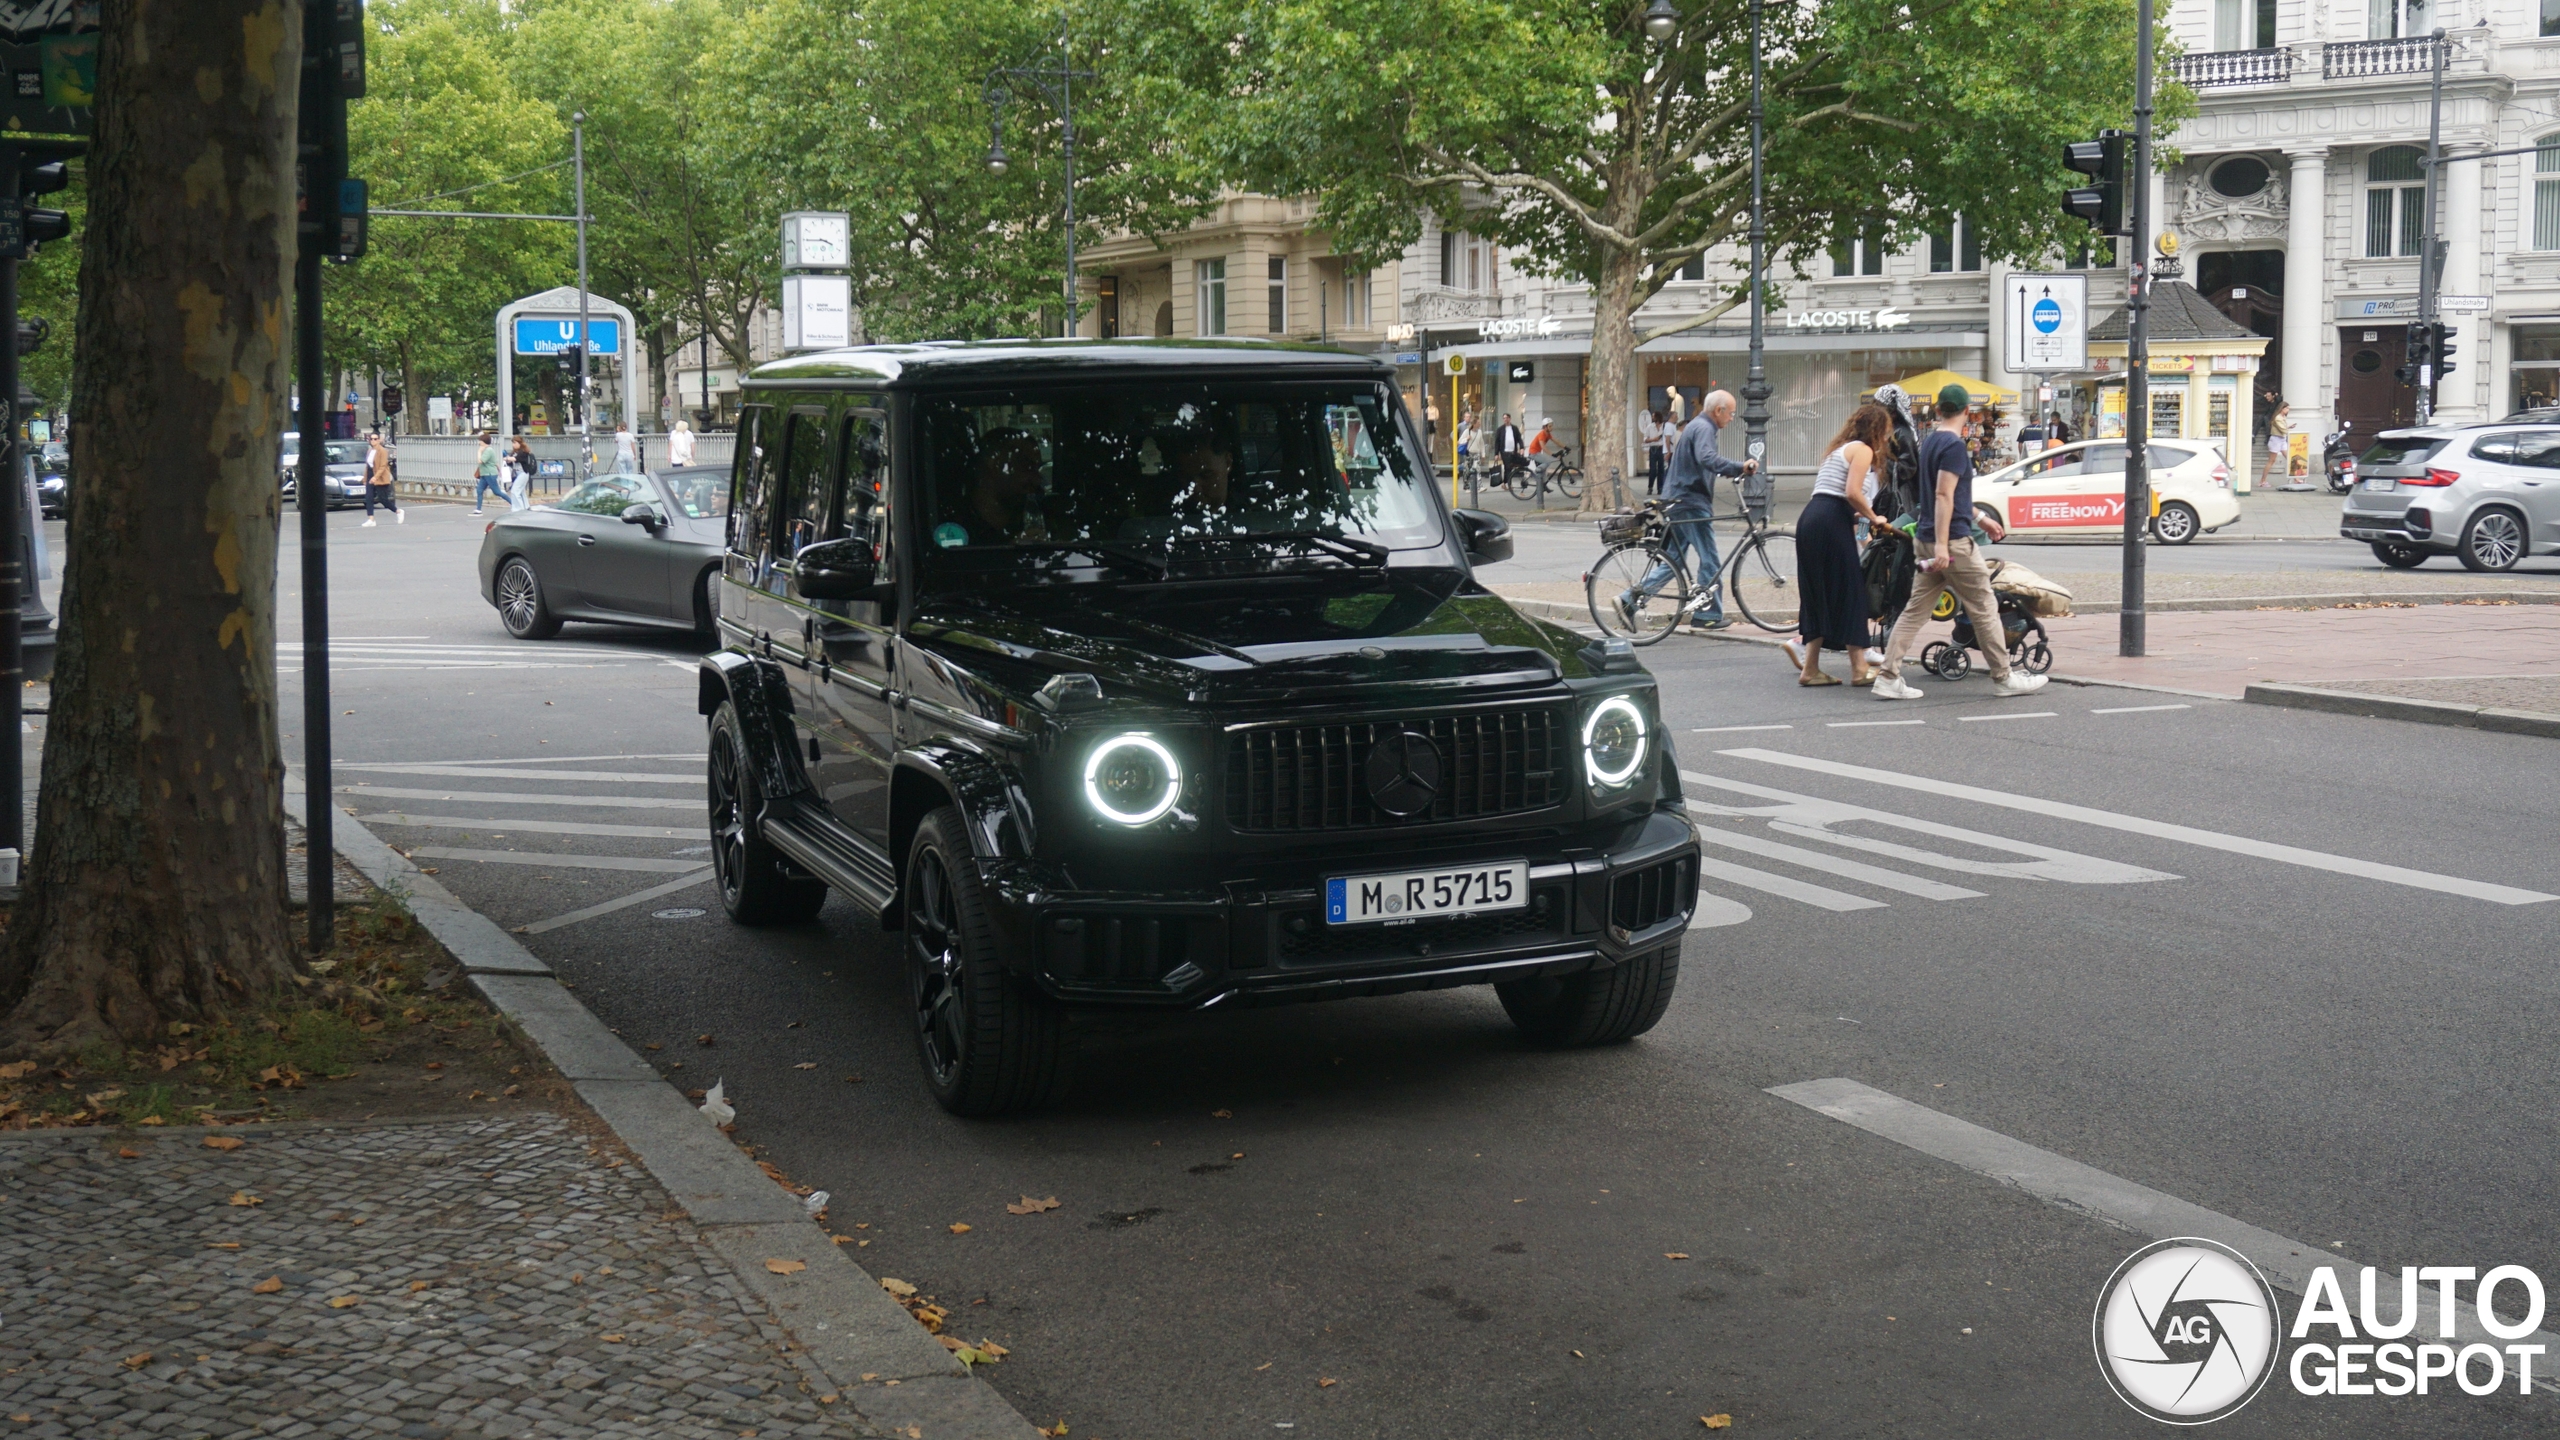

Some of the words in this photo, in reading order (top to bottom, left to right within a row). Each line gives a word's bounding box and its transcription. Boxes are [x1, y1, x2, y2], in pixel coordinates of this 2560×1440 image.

[2443, 298, 2485, 307] Uhlandstraße
[1786, 310, 1872, 328] LACOSTE
[559, 321, 575, 340] U
[1478, 319, 1536, 336] LACOSTE
[2031, 506, 2109, 519] FREENOW
[1333, 905, 1341, 915] D
